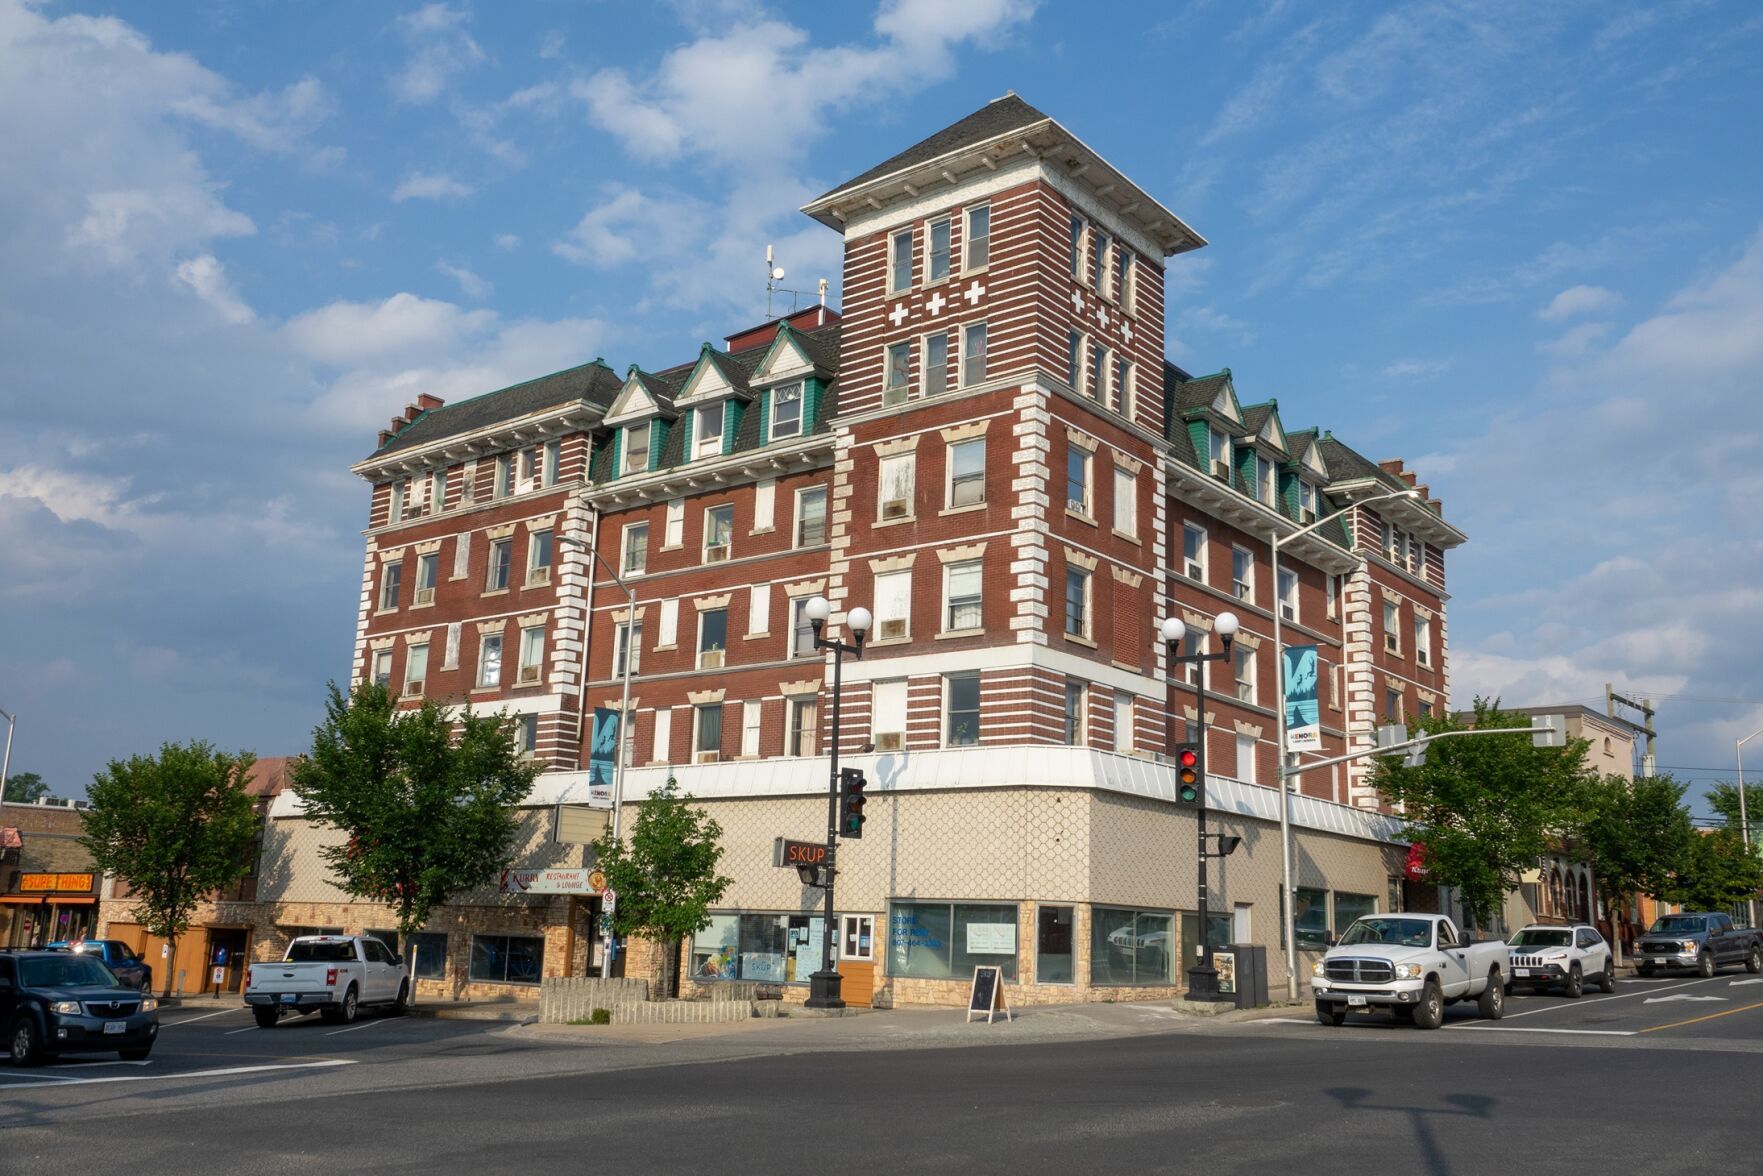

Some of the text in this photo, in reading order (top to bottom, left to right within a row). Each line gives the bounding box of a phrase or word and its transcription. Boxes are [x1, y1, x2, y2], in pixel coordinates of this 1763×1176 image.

[546, 872, 580, 881] RESTAURANT
[562, 881, 583, 889] LOUNGE
[892, 928, 908, 936] FOR
